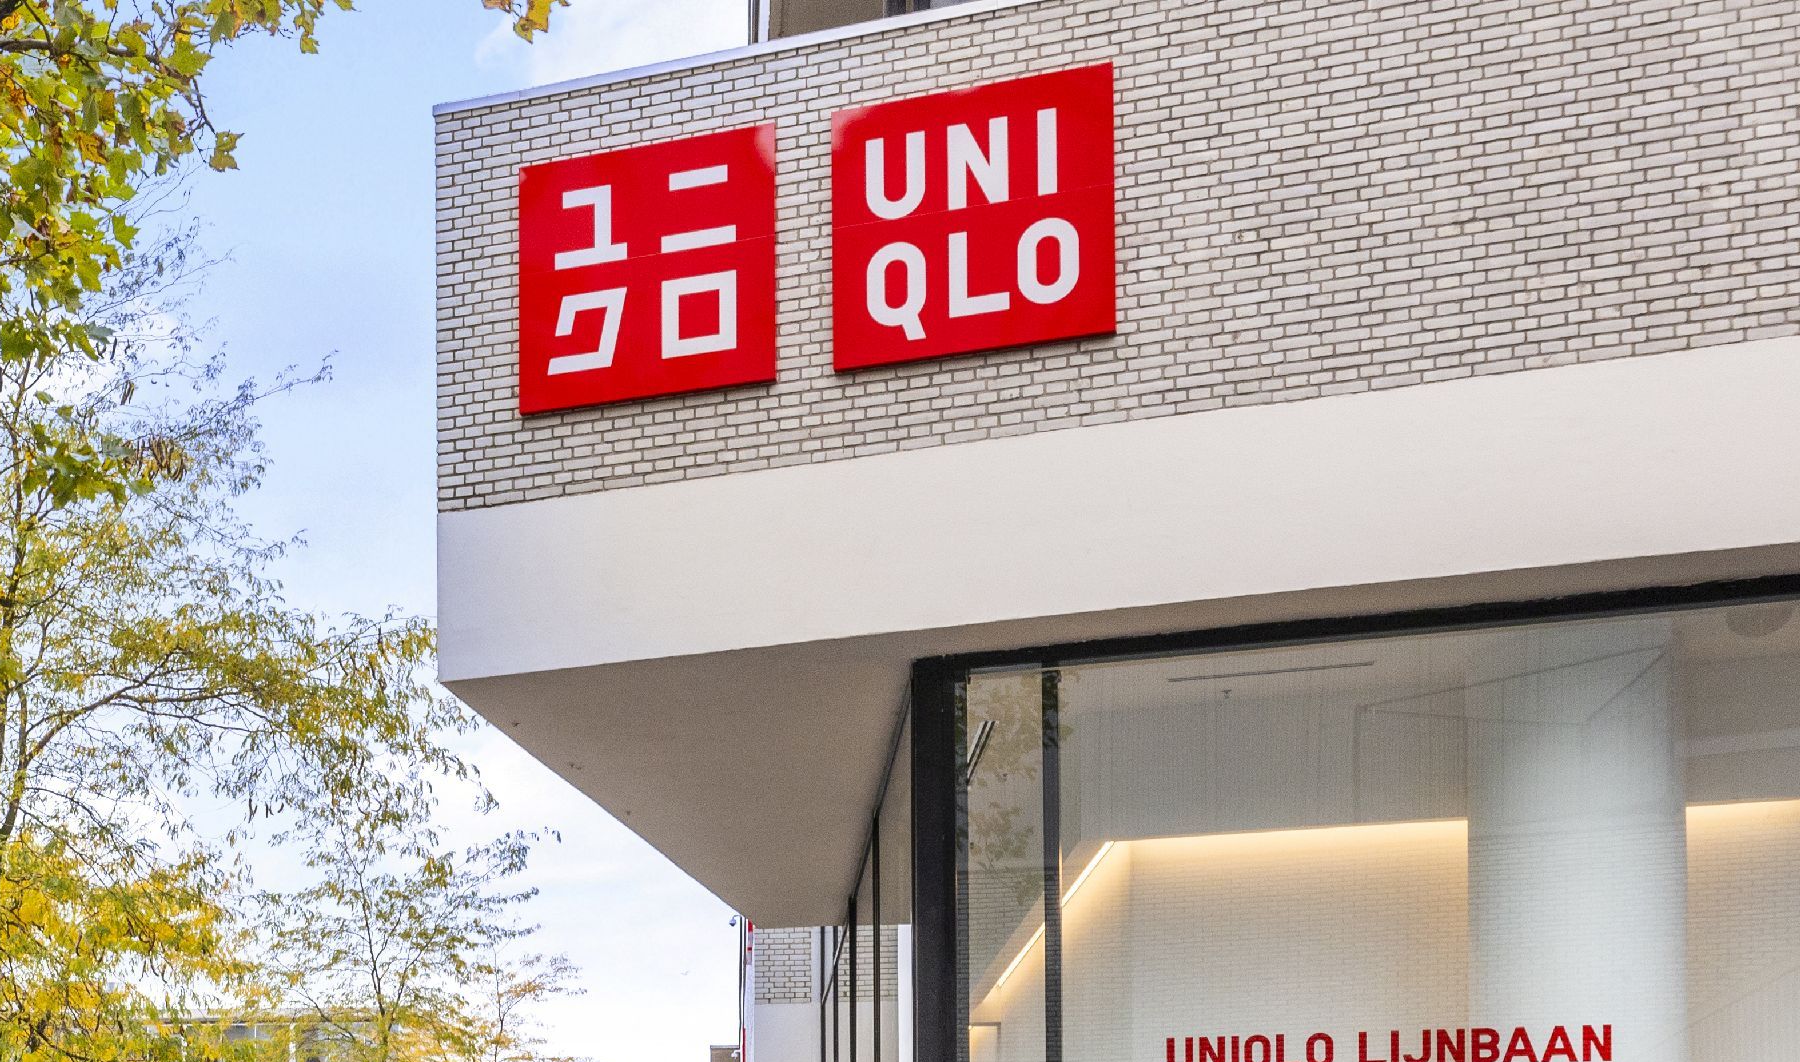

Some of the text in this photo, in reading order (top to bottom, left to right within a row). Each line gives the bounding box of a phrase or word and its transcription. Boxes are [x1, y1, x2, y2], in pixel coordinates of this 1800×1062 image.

[554, 164, 738, 271] ユニ
[864, 108, 1059, 221] UNI
[547, 270, 738, 376] クロ
[865, 217, 1081, 341] QLO
